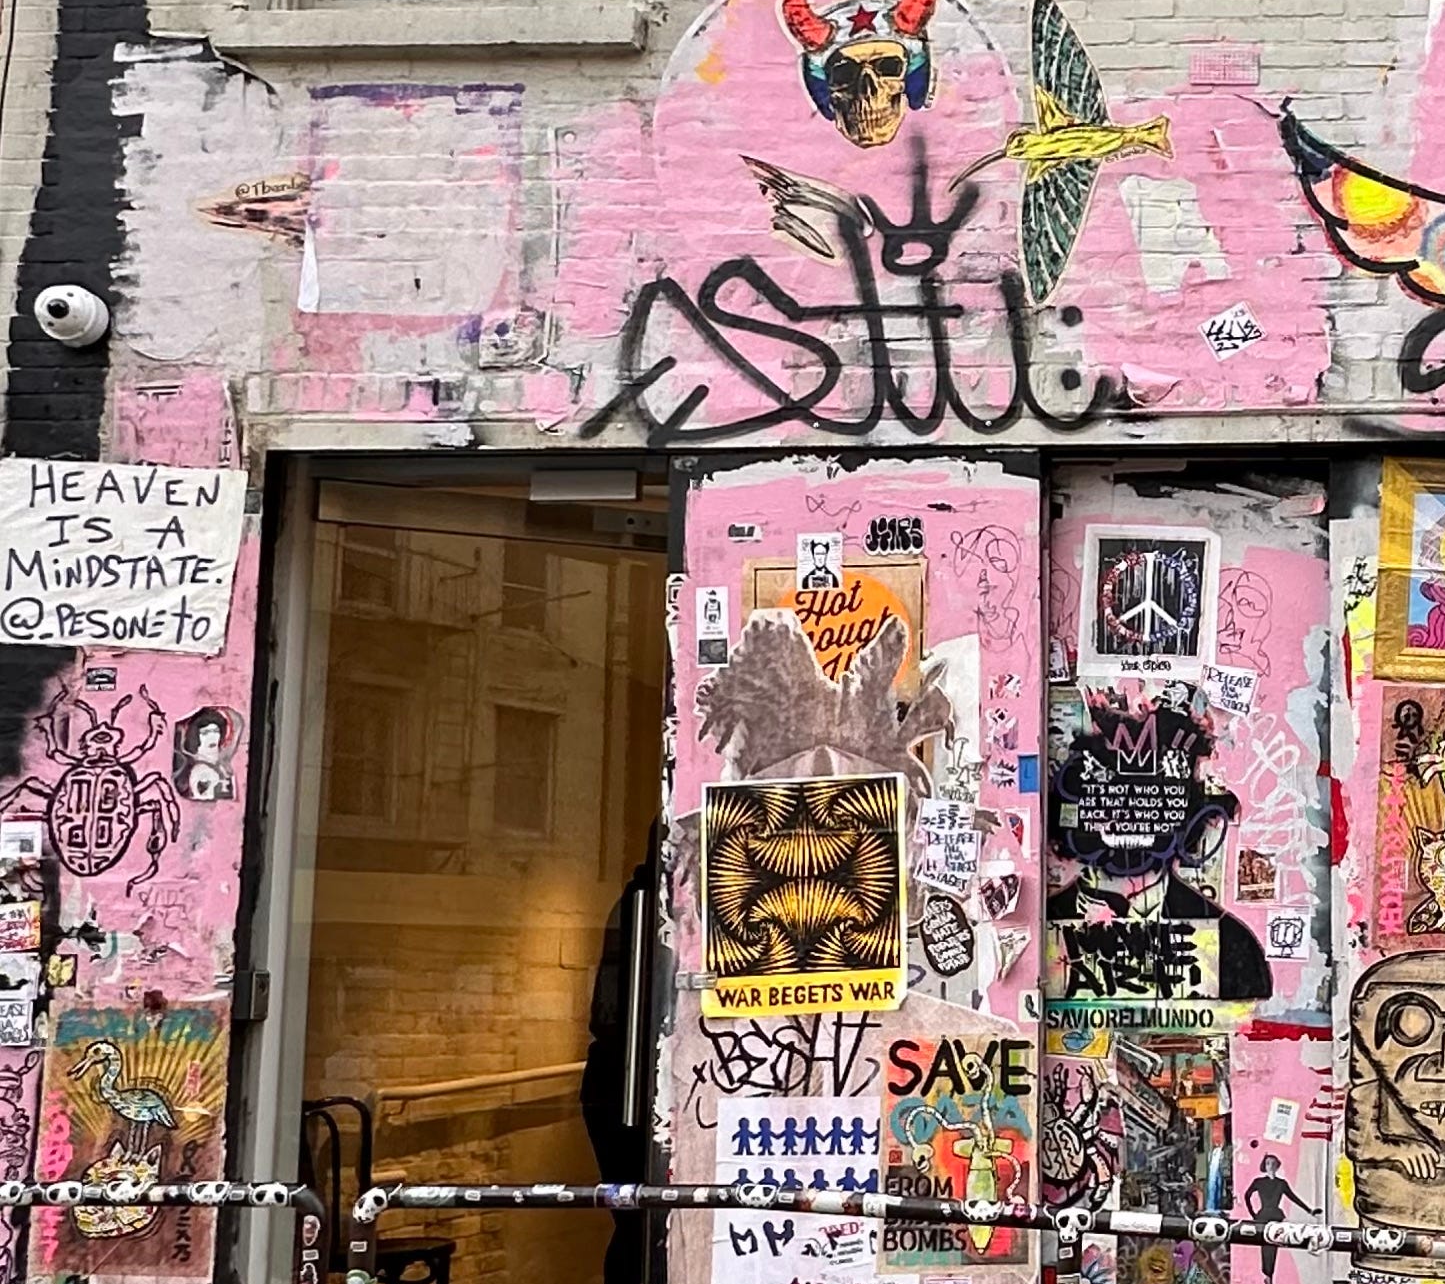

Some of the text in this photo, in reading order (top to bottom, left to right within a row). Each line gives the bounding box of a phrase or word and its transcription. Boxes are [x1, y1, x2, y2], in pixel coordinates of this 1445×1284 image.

[29, 463, 220, 507] HEAVEN
[46, 514, 186, 549] IS A
[795, 581, 863, 622] Hot
[1078, 797, 1188, 808] ARE THAT HOLDS YOU
[1108, 784, 1129, 795] NOT
[1134, 784, 1159, 795] WHO
[1163, 785, 1186, 795] YOU
[1134, 810, 1159, 819] WHO
[1163, 811, 1185, 820] YOU
[717, 981, 895, 1008] WAR BEGETS WAR
[888, 1039, 1036, 1098] SAVE
[886, 1176, 954, 1201] FROM
[883, 1228, 968, 1253] BOMBS
